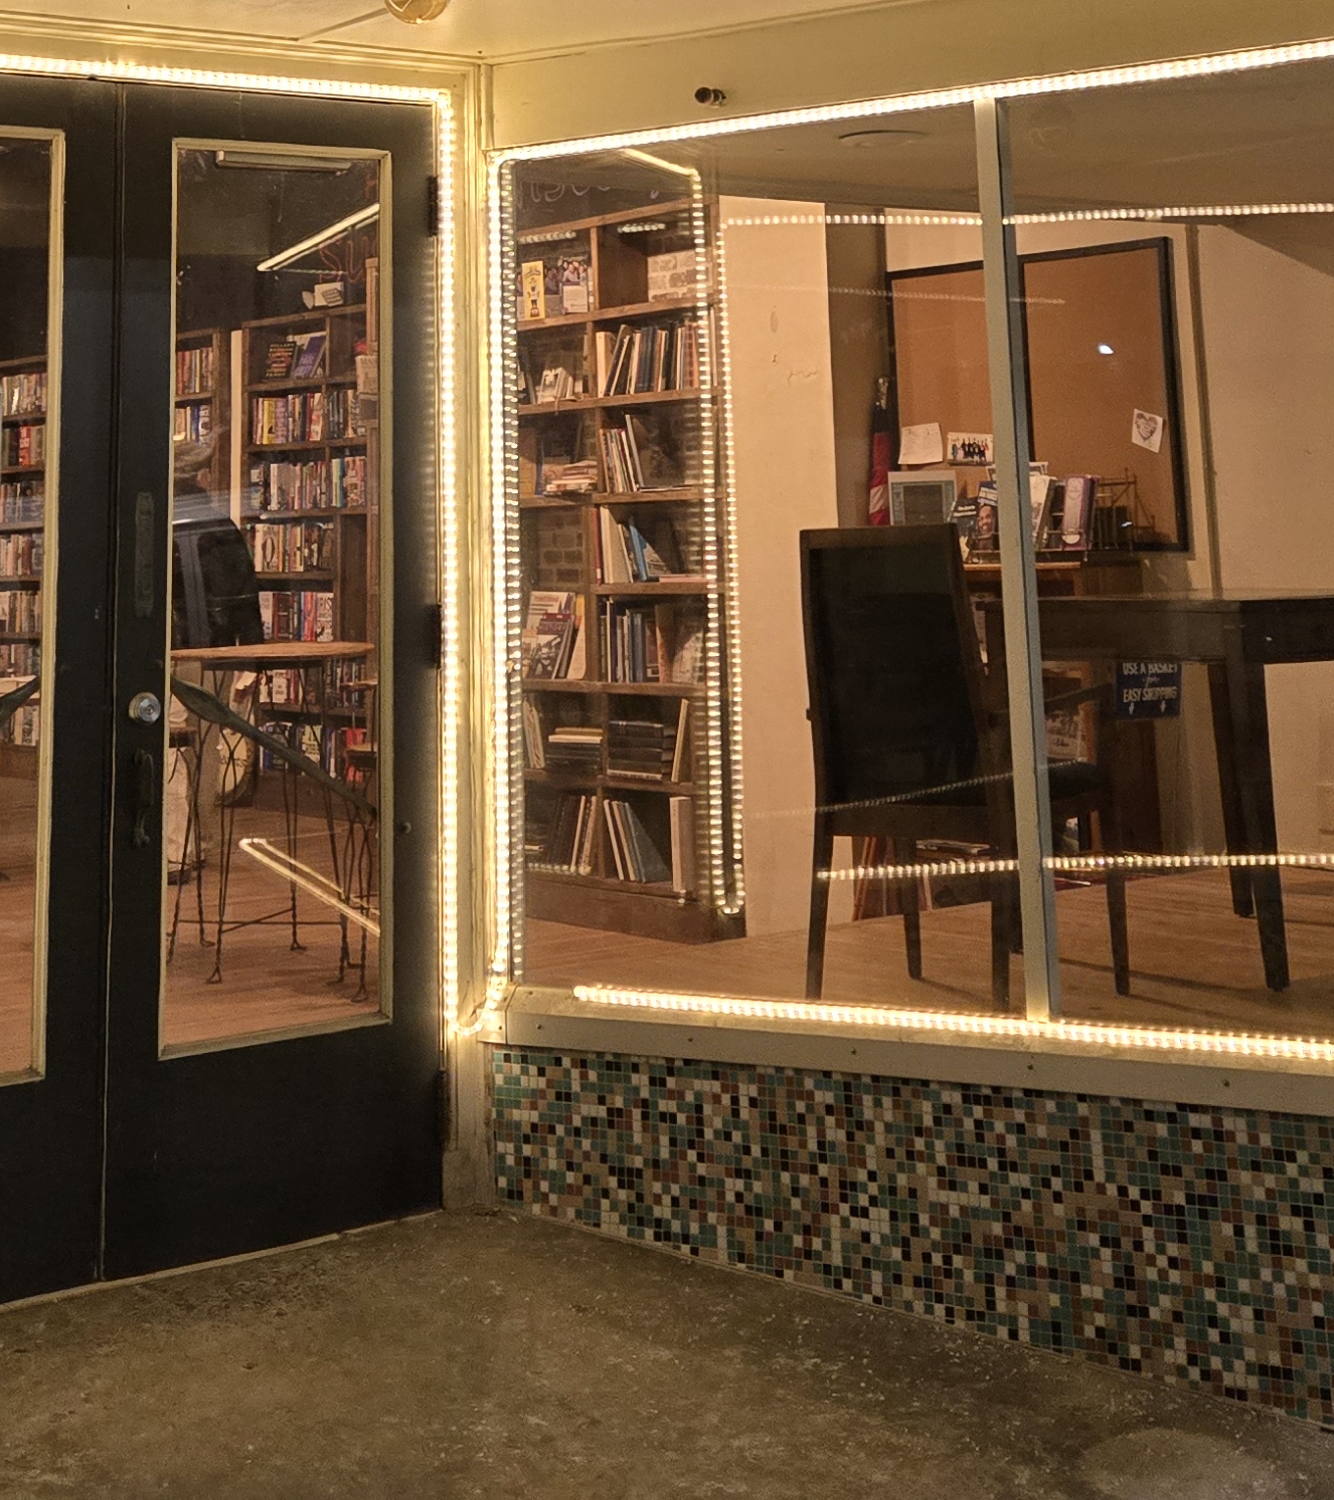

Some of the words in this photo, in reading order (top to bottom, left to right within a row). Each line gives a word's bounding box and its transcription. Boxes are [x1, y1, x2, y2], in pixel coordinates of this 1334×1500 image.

[1122, 662, 1138, 675] USE
[1140, 662, 1146, 674] A
[1123, 687, 1142, 703] EASY
